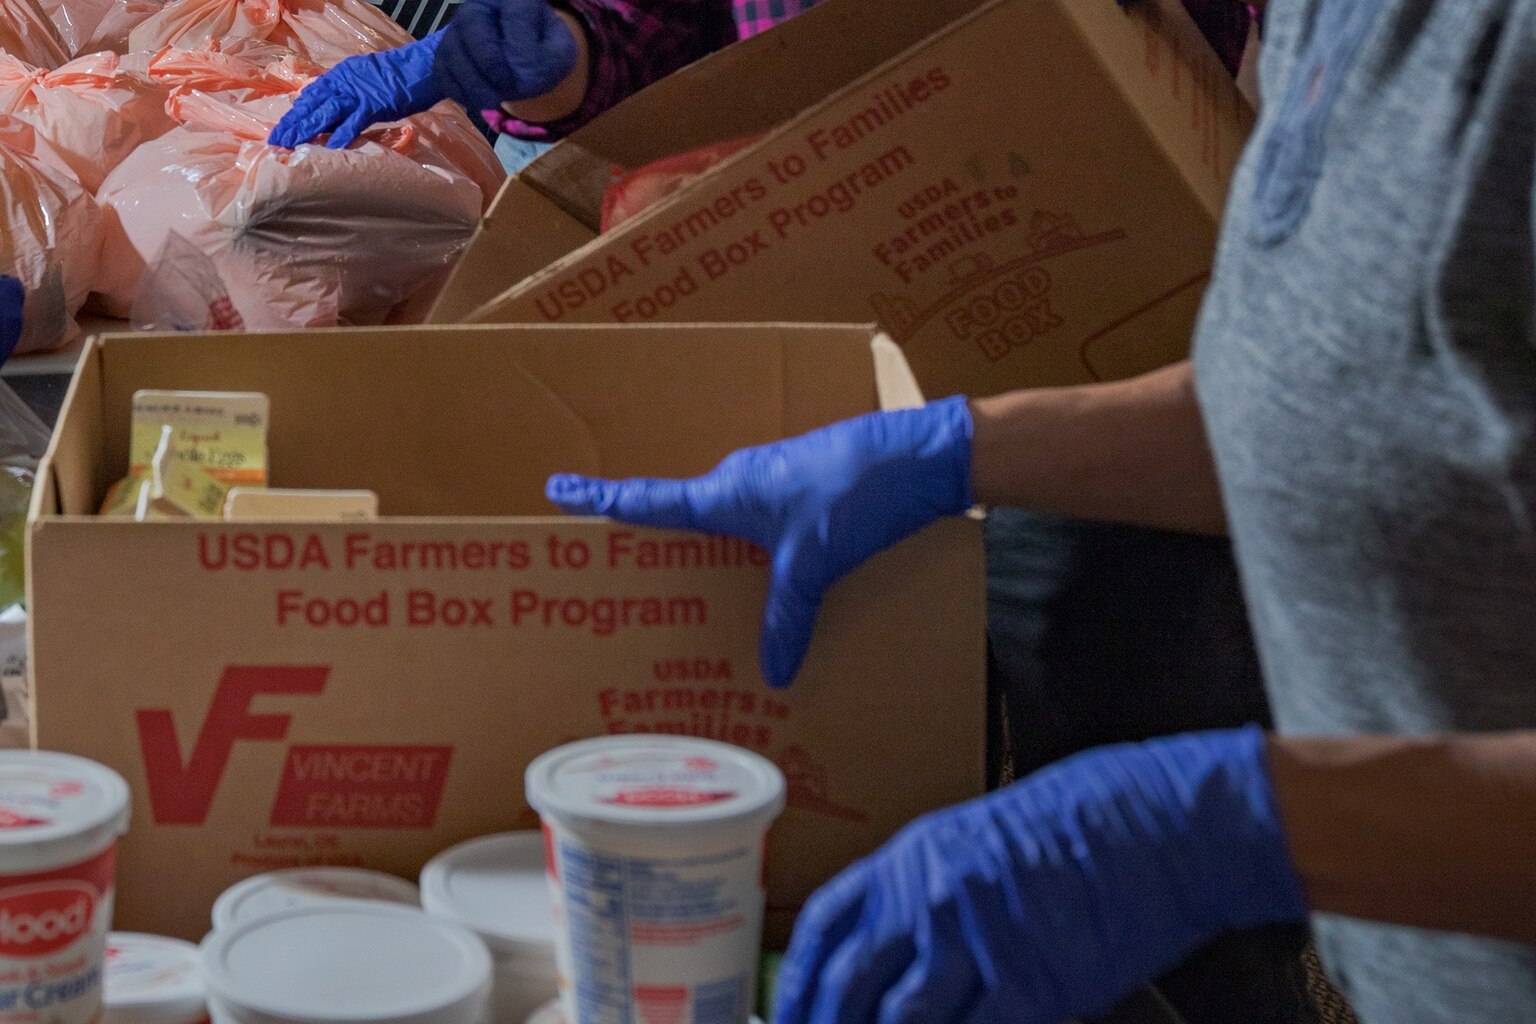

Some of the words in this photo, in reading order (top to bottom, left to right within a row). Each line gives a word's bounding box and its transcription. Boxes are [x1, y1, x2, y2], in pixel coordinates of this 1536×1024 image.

[535, 254, 634, 323] USDA
[631, 177, 768, 268] Farmers
[767, 152, 807, 187] to
[806, 65, 953, 162] Families
[898, 178, 960, 221] USDA
[611, 266, 700, 323] Food
[698, 231, 769, 283] Box
[768, 143, 915, 241] Program
[872, 190, 992, 266] Farmers
[894, 207, 1019, 285] Families
[197, 532, 330, 571] USDA
[344, 532, 531, 571] Farmers
[546, 534, 591, 571] to
[606, 531, 773, 570] Familie
[275, 589, 390, 627] Food
[405, 589, 494, 627] Box
[510, 589, 707, 636] Program
[654, 658, 732, 681] USDA
[597, 689, 756, 717] Farmers
[291, 752, 439, 782] VINCENT
[306, 792, 425, 823] FARMS
